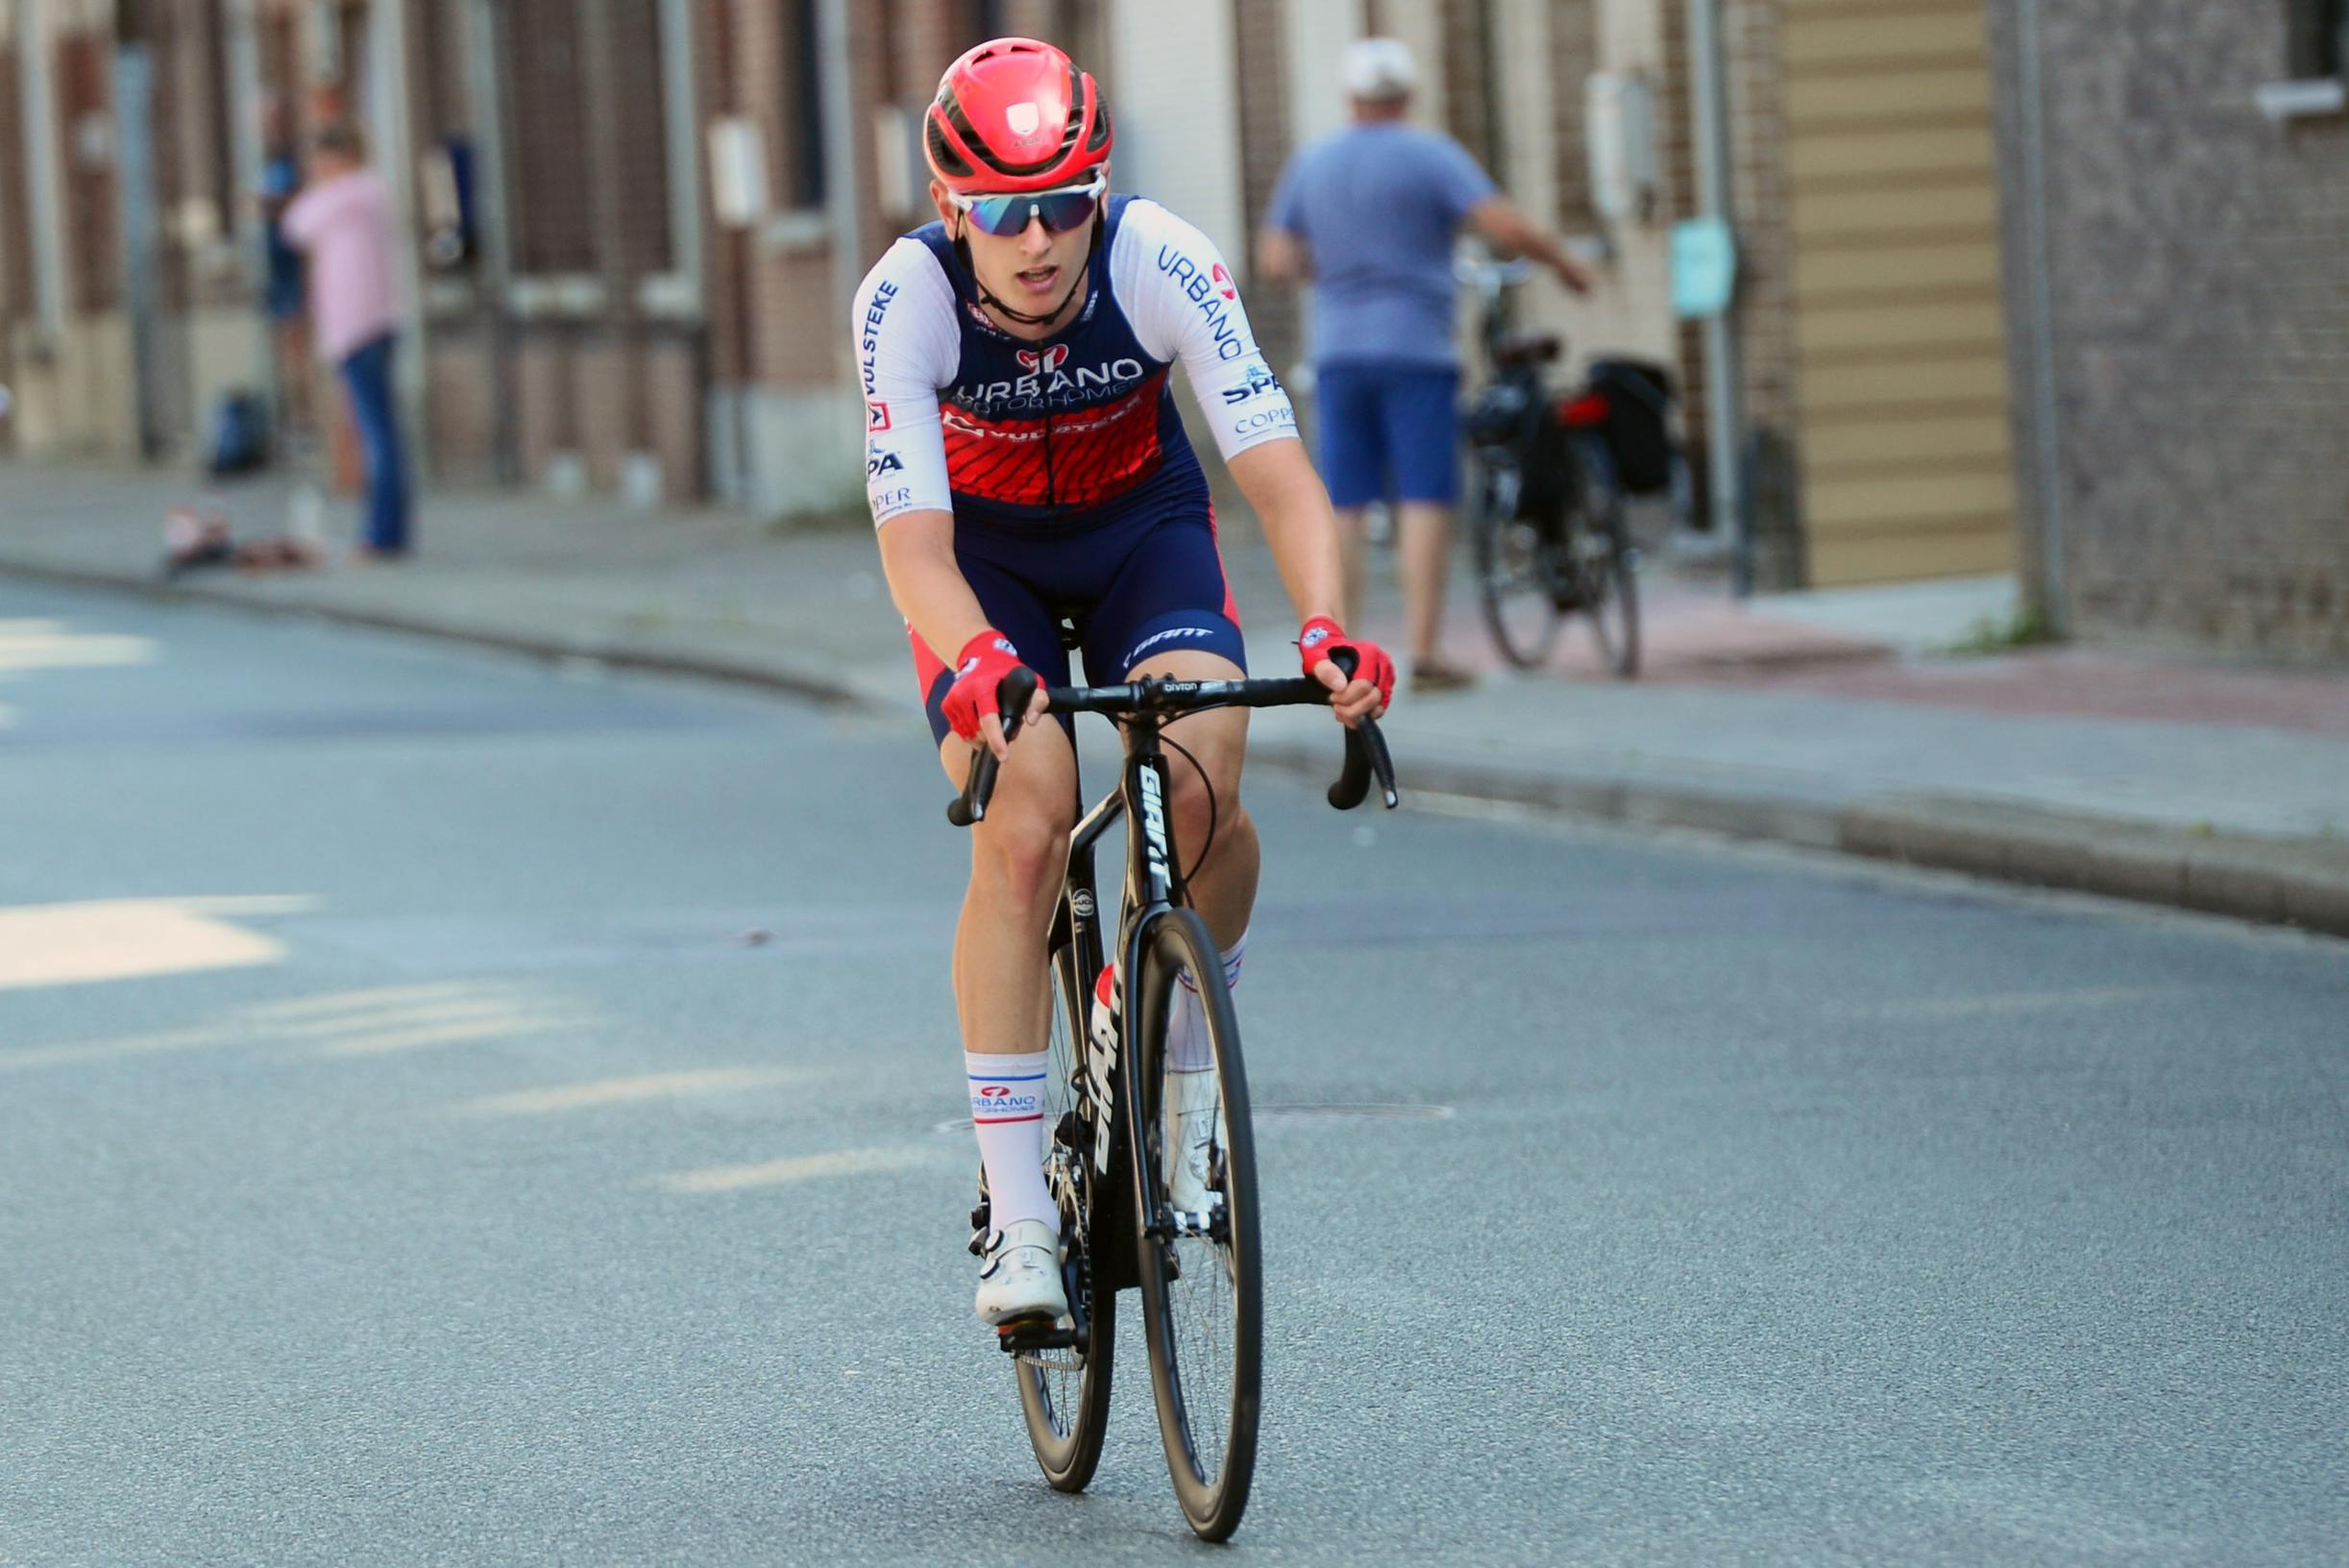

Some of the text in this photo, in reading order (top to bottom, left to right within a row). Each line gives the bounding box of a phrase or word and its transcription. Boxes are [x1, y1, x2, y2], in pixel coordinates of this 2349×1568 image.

[863, 280, 898, 396] VULSTEKE
[1158, 245, 1242, 360] URBANO
[958, 358, 1143, 403] URBANO
[1139, 764, 1172, 889] GIANT
[971, 1095, 1037, 1107] RBANO
